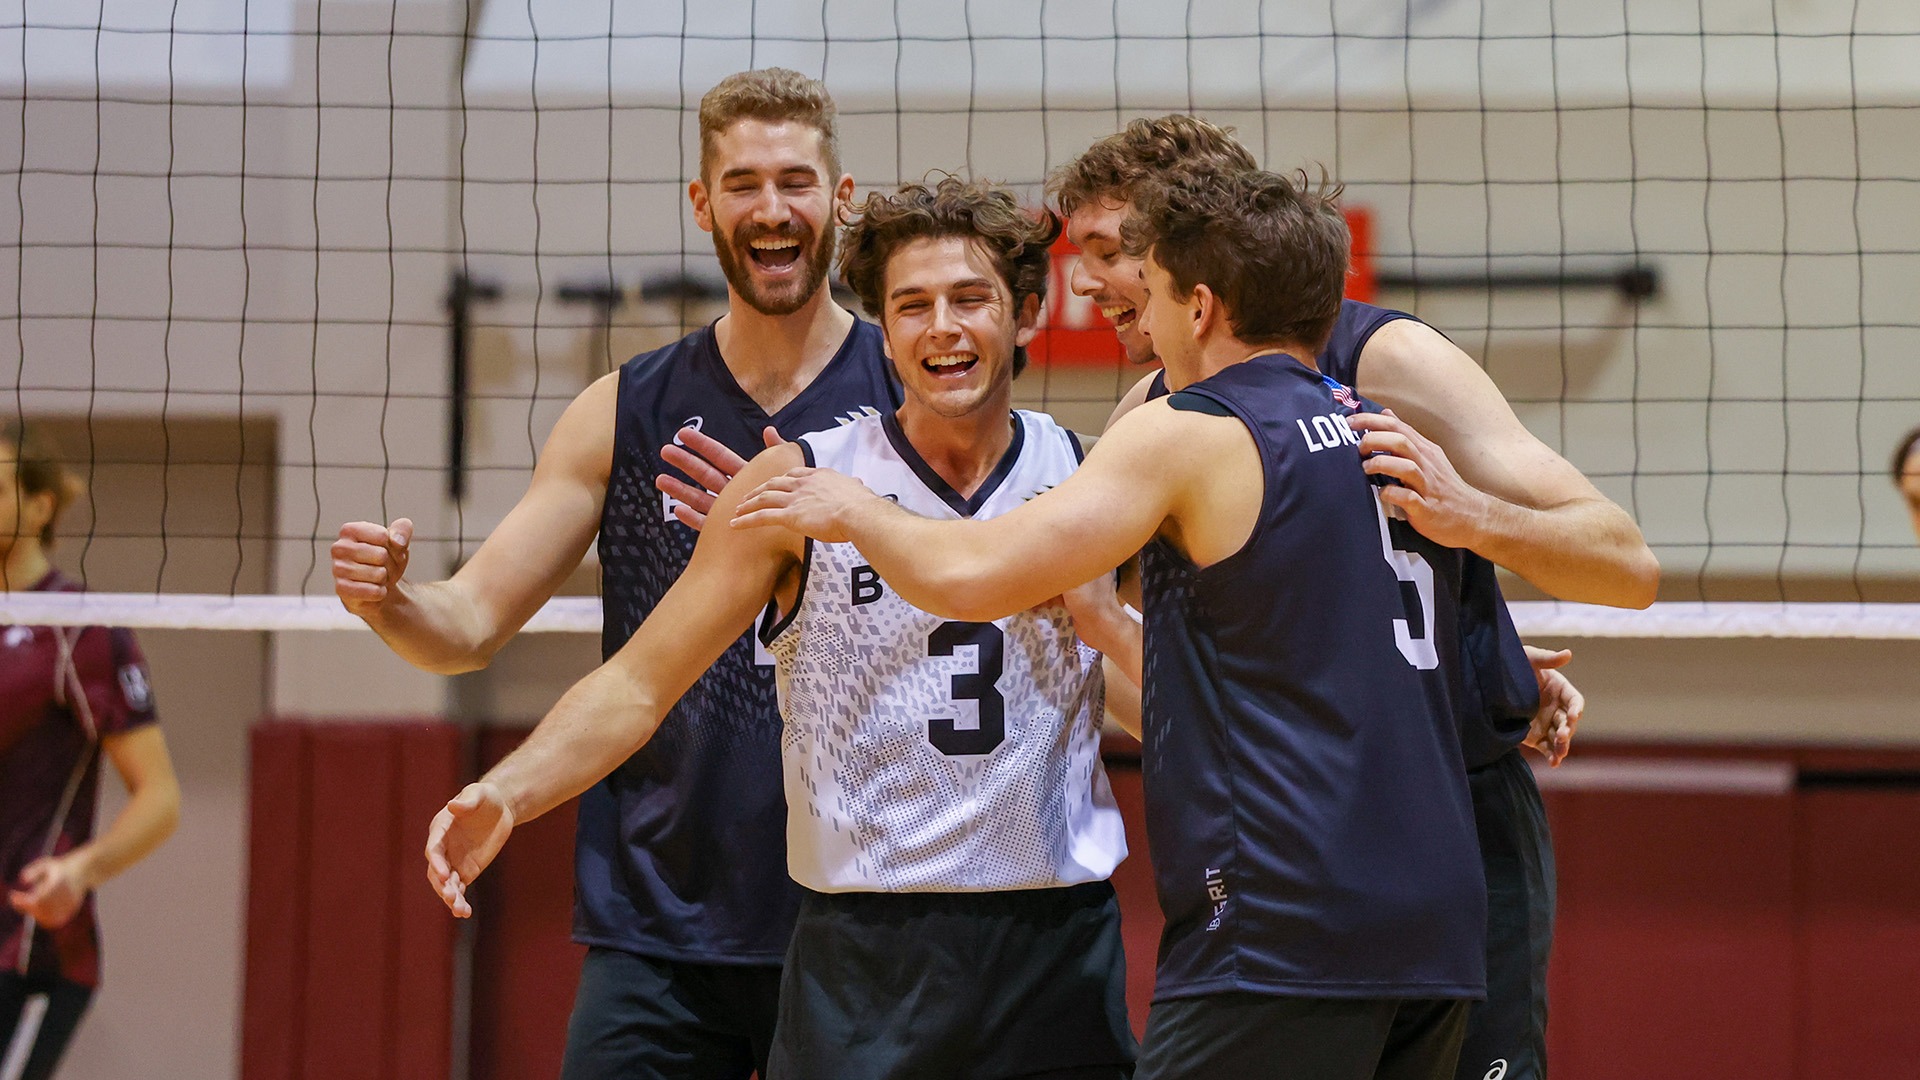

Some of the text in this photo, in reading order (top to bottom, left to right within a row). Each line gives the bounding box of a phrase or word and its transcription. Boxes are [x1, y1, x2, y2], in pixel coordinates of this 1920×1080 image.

[1296, 412, 1363, 453] LON
[1370, 484, 1439, 670] 5
[928, 621, 1005, 755] 3
